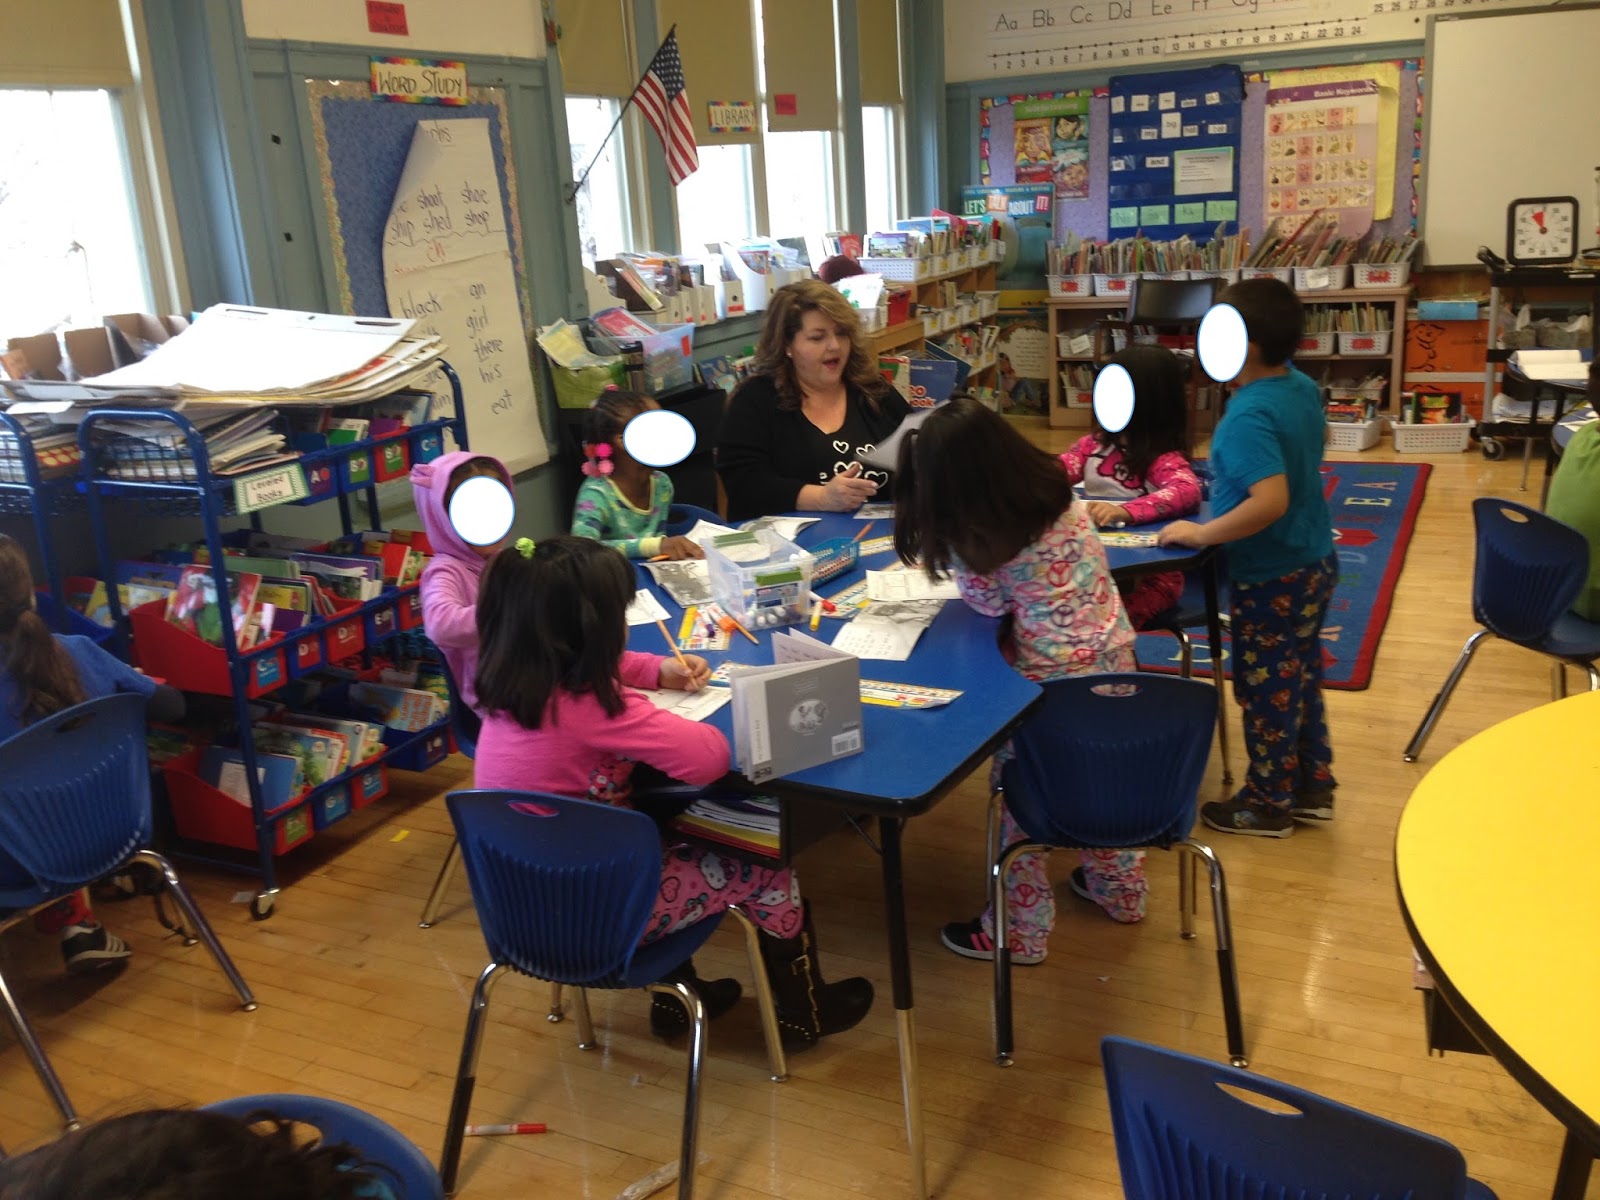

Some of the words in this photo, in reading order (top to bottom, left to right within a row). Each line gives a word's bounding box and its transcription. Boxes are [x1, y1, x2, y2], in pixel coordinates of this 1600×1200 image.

[995, 13, 1018, 31] Aa
[1033, 9, 1055, 27] Bb
[1070, 5, 1093, 24] Cc
[1108, 0, 1132, 20] Dd
[1152, 0, 1172, 16] Ee
[1373, 3, 1384, 13] 25
[1391, 1, 1401, 11] 26
[992, 62, 998, 70] 1
[1006, 60, 1012, 70] 2
[1020, 58, 1026, 68] 3
[1034, 56, 1040, 66] 4
[1049, 55, 1055, 66] 5
[1063, 54, 1069, 64] 6
[1078, 53, 1084, 62] 7
[1092, 51, 1098, 61] 8
[1107, 49, 1113, 59] 9
[1121, 48, 1130, 57] 10
[1136, 47, 1144, 56] 11
[1151, 45, 1160, 55] 12
[1172, 42, 1180, 51] 13
[1187, 41, 1196, 50] 14
[1203, 40, 1212, 49] 15
[1219, 38, 1228, 47] 16
[1235, 36, 1244, 45] 17
[1252, 35, 1260, 44] 18
[1268, 33, 1277, 43] 19
[1284, 32, 1294, 41] 20
[1300, 30, 1310, 40] 21
[1317, 28, 1328, 38] 22
[1334, 27, 1345, 37] 23
[1351, 26, 1361, 36] 24
[378, 71, 417, 94] WORD
[421, 69, 463, 97] STUDY
[1314, 89, 1334, 98] Basic
[713, 108, 756, 126] LIBRARY
[964, 199, 986, 215] LET'S
[987, 195, 1008, 211] TALK
[1009, 200, 1034, 216] ABOUT
[1036, 195, 1049, 211] IT!
[400, 290, 442, 319] black
[466, 305, 489, 339] girl
[474, 339, 503, 363] there
[479, 363, 503, 384] his
[421, 439, 431, 451] C
[311, 470, 321, 484] A
[256, 490, 283, 503] Books
[337, 627, 348, 641] D
